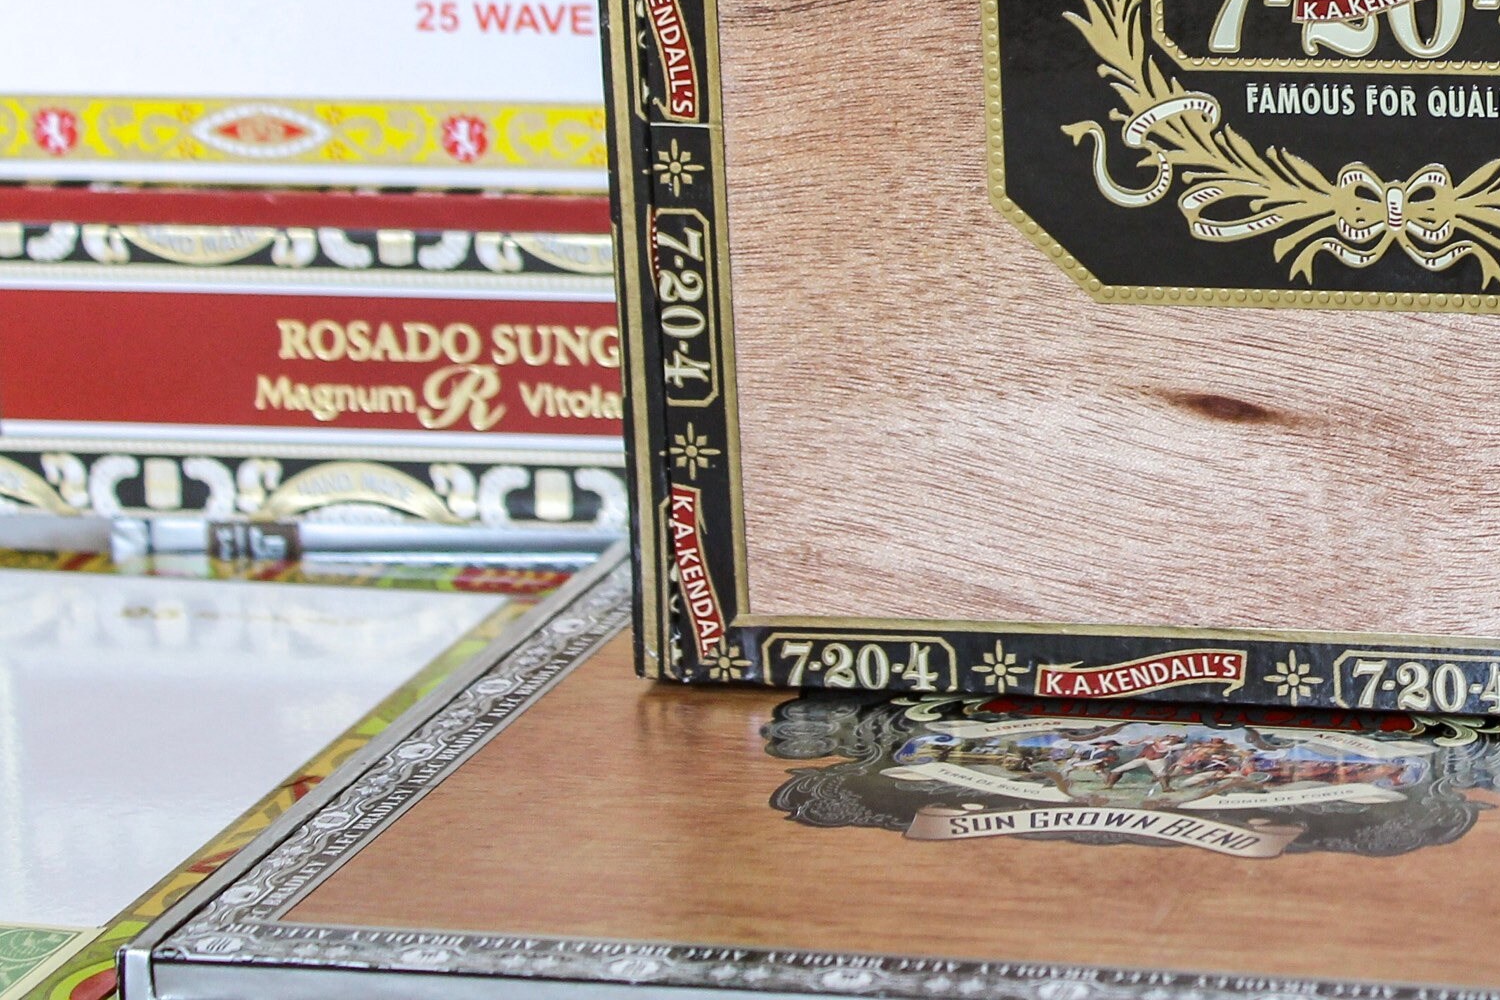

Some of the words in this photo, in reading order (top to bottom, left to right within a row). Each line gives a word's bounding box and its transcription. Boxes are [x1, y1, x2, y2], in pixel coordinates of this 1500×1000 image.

[415, 0, 459, 33] 25
[473, 2, 594, 36] WAVE
[1246, 83, 1355, 116] FAMOUS
[1366, 85, 1417, 117] FOR
[653, 225, 713, 388] 7-20-4
[276, 319, 482, 364] ROSADO
[491, 324, 621, 368] SUNG
[254, 374, 417, 422] Magnum
[780, 640, 939, 690] 7-20-4
[1045, 652, 1238, 695] K.A.KENDALL'S
